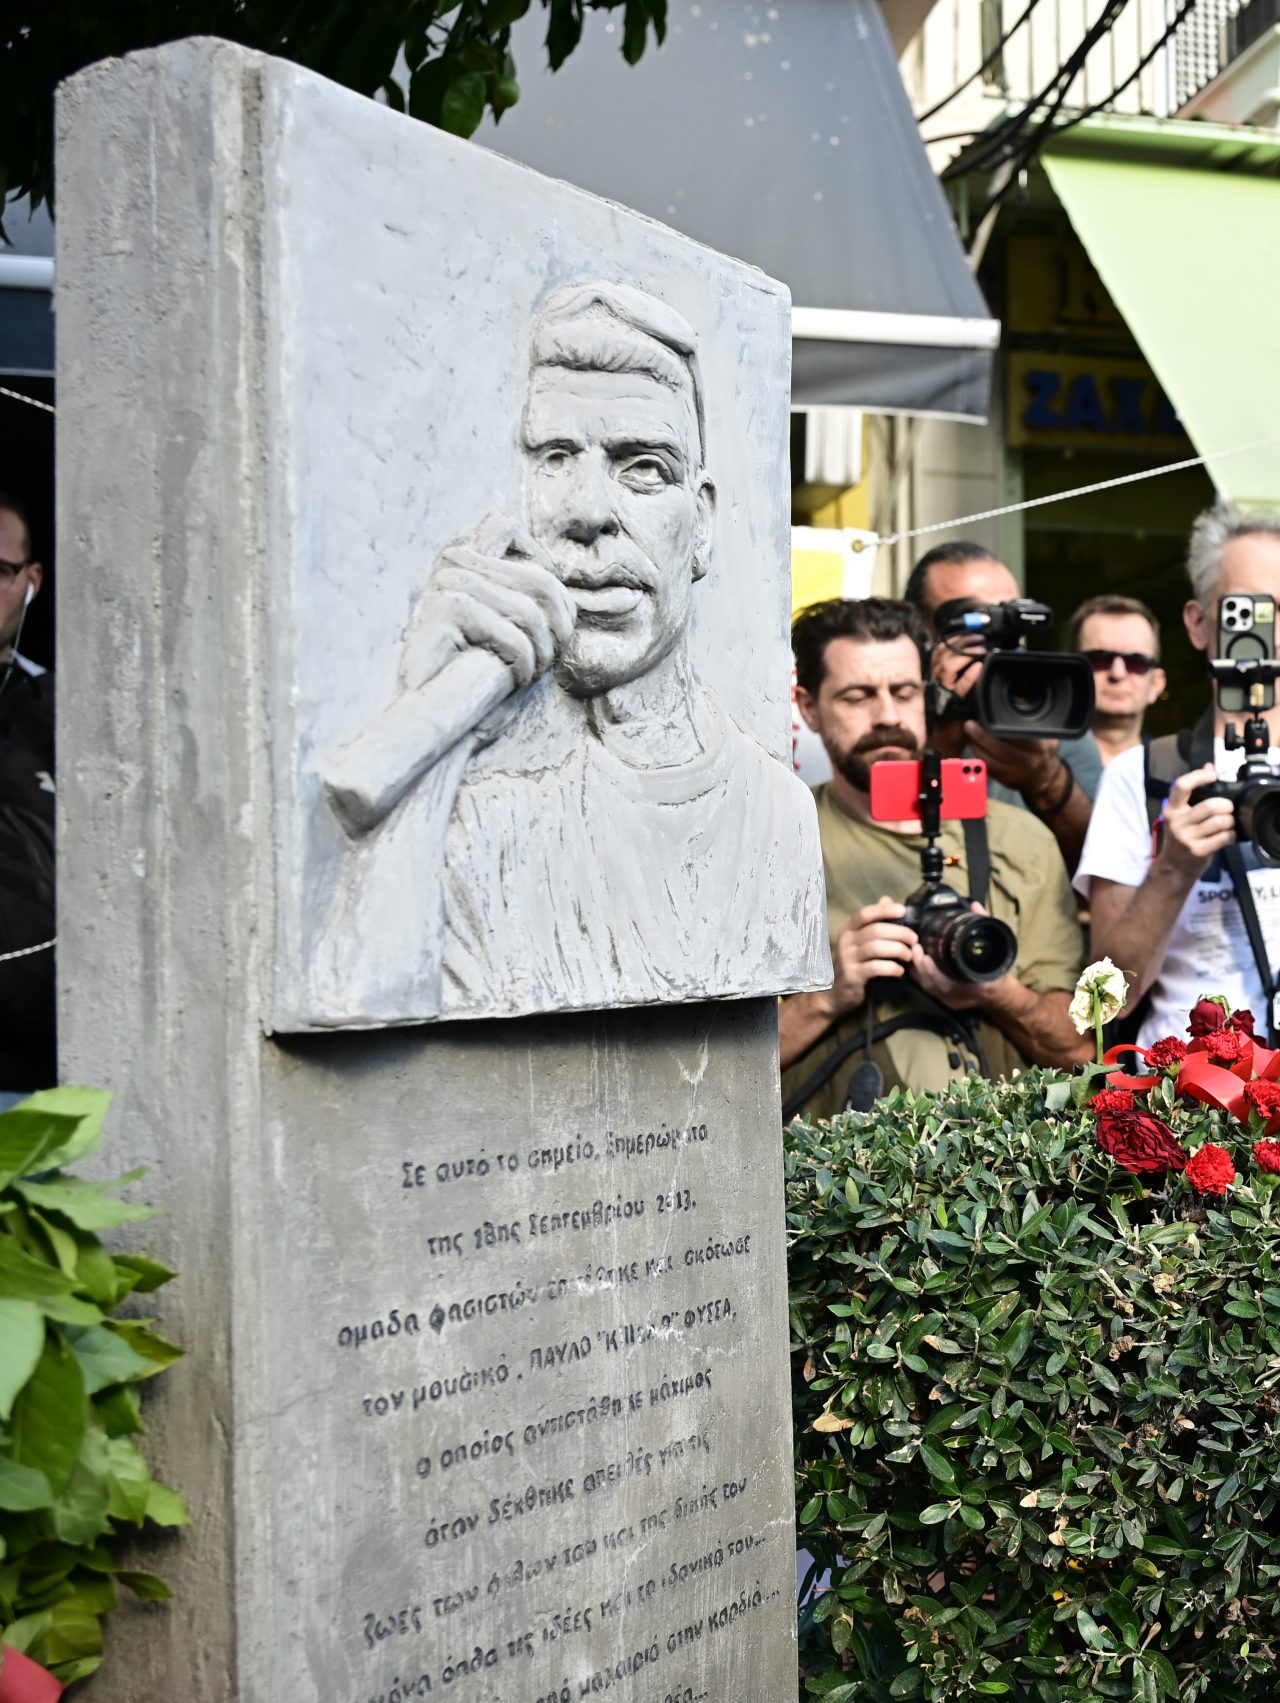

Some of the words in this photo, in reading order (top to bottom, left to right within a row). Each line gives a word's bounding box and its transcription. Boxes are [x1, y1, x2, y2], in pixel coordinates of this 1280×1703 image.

[1198, 887, 1267, 903] SPOY,
[402, 1160, 426, 1188] Σε
[436, 1148, 490, 1183] αυτό
[497, 1154, 519, 1172] το
[427, 1232, 464, 1256] της
[684, 1235, 751, 1266] σκότωσε
[363, 1390, 405, 1416] τον
[530, 1335, 592, 1369] ΠΑΥΛΟ
[416, 1456, 431, 1479] ο
[440, 1430, 514, 1471] οποίος
[650, 1367, 712, 1408] μάχιμος
[425, 1517, 479, 1549] όταν
[433, 1585, 479, 1617] των
[666, 1620, 704, 1654] στην
